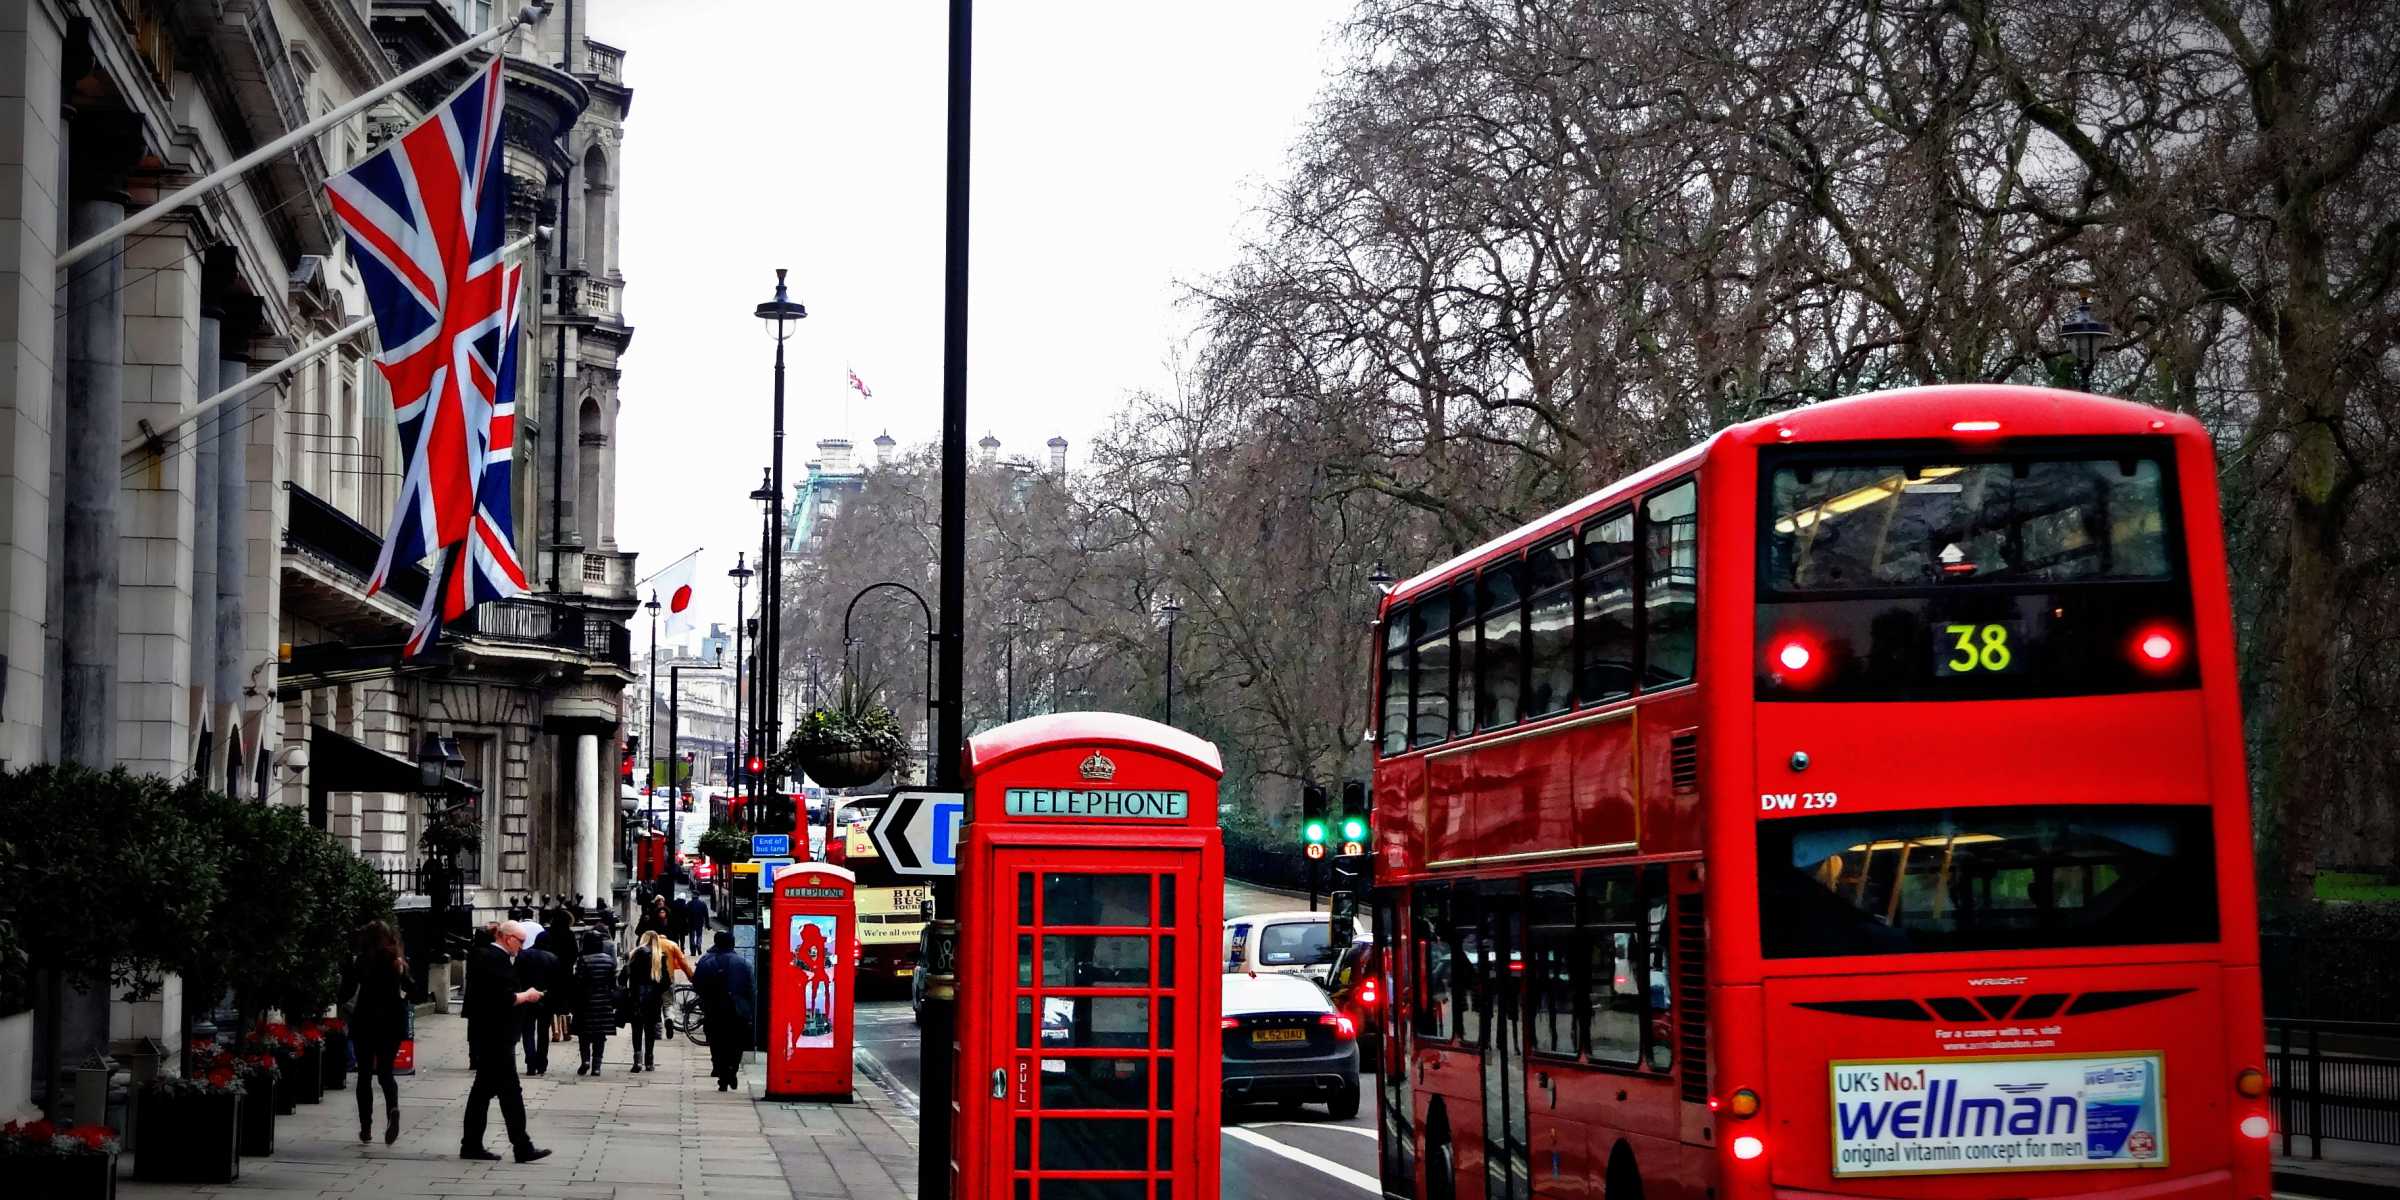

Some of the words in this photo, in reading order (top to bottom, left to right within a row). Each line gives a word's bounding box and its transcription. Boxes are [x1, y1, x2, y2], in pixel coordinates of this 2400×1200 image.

[1945, 623, 2011, 672] 38
[1012, 790, 1181, 815] TELEPHONE
[1761, 793, 1797, 810] DW
[1802, 792, 1838, 808] 239
[759, 836, 773, 844] End
[774, 836, 782, 844] of
[893, 888, 922, 897] BIG
[893, 896, 922, 905] BUS
[863, 929, 887, 937] We're
[889, 928, 900, 936] all
[1967, 976, 2029, 986] WRIGHT
[1935, 1029, 1952, 1038] For
[1953, 1030, 1962, 1038] a
[1963, 1029, 1997, 1038] career
[1999, 1027, 2020, 1036] with
[2040, 1025, 2062, 1035] visit
[1019, 1063, 1027, 1103] PULL
[1838, 1071, 1879, 1092] UK's
[1884, 1069, 1926, 1091] No.1
[1837, 1079, 2079, 1140] wellman
[1842, 1142, 1900, 1167] original
[1904, 1141, 1961, 1162] vitamin
[1966, 1140, 2021, 1163] concept
[2026, 1138, 2046, 1158] for
[2050, 1140, 2083, 1158] men
